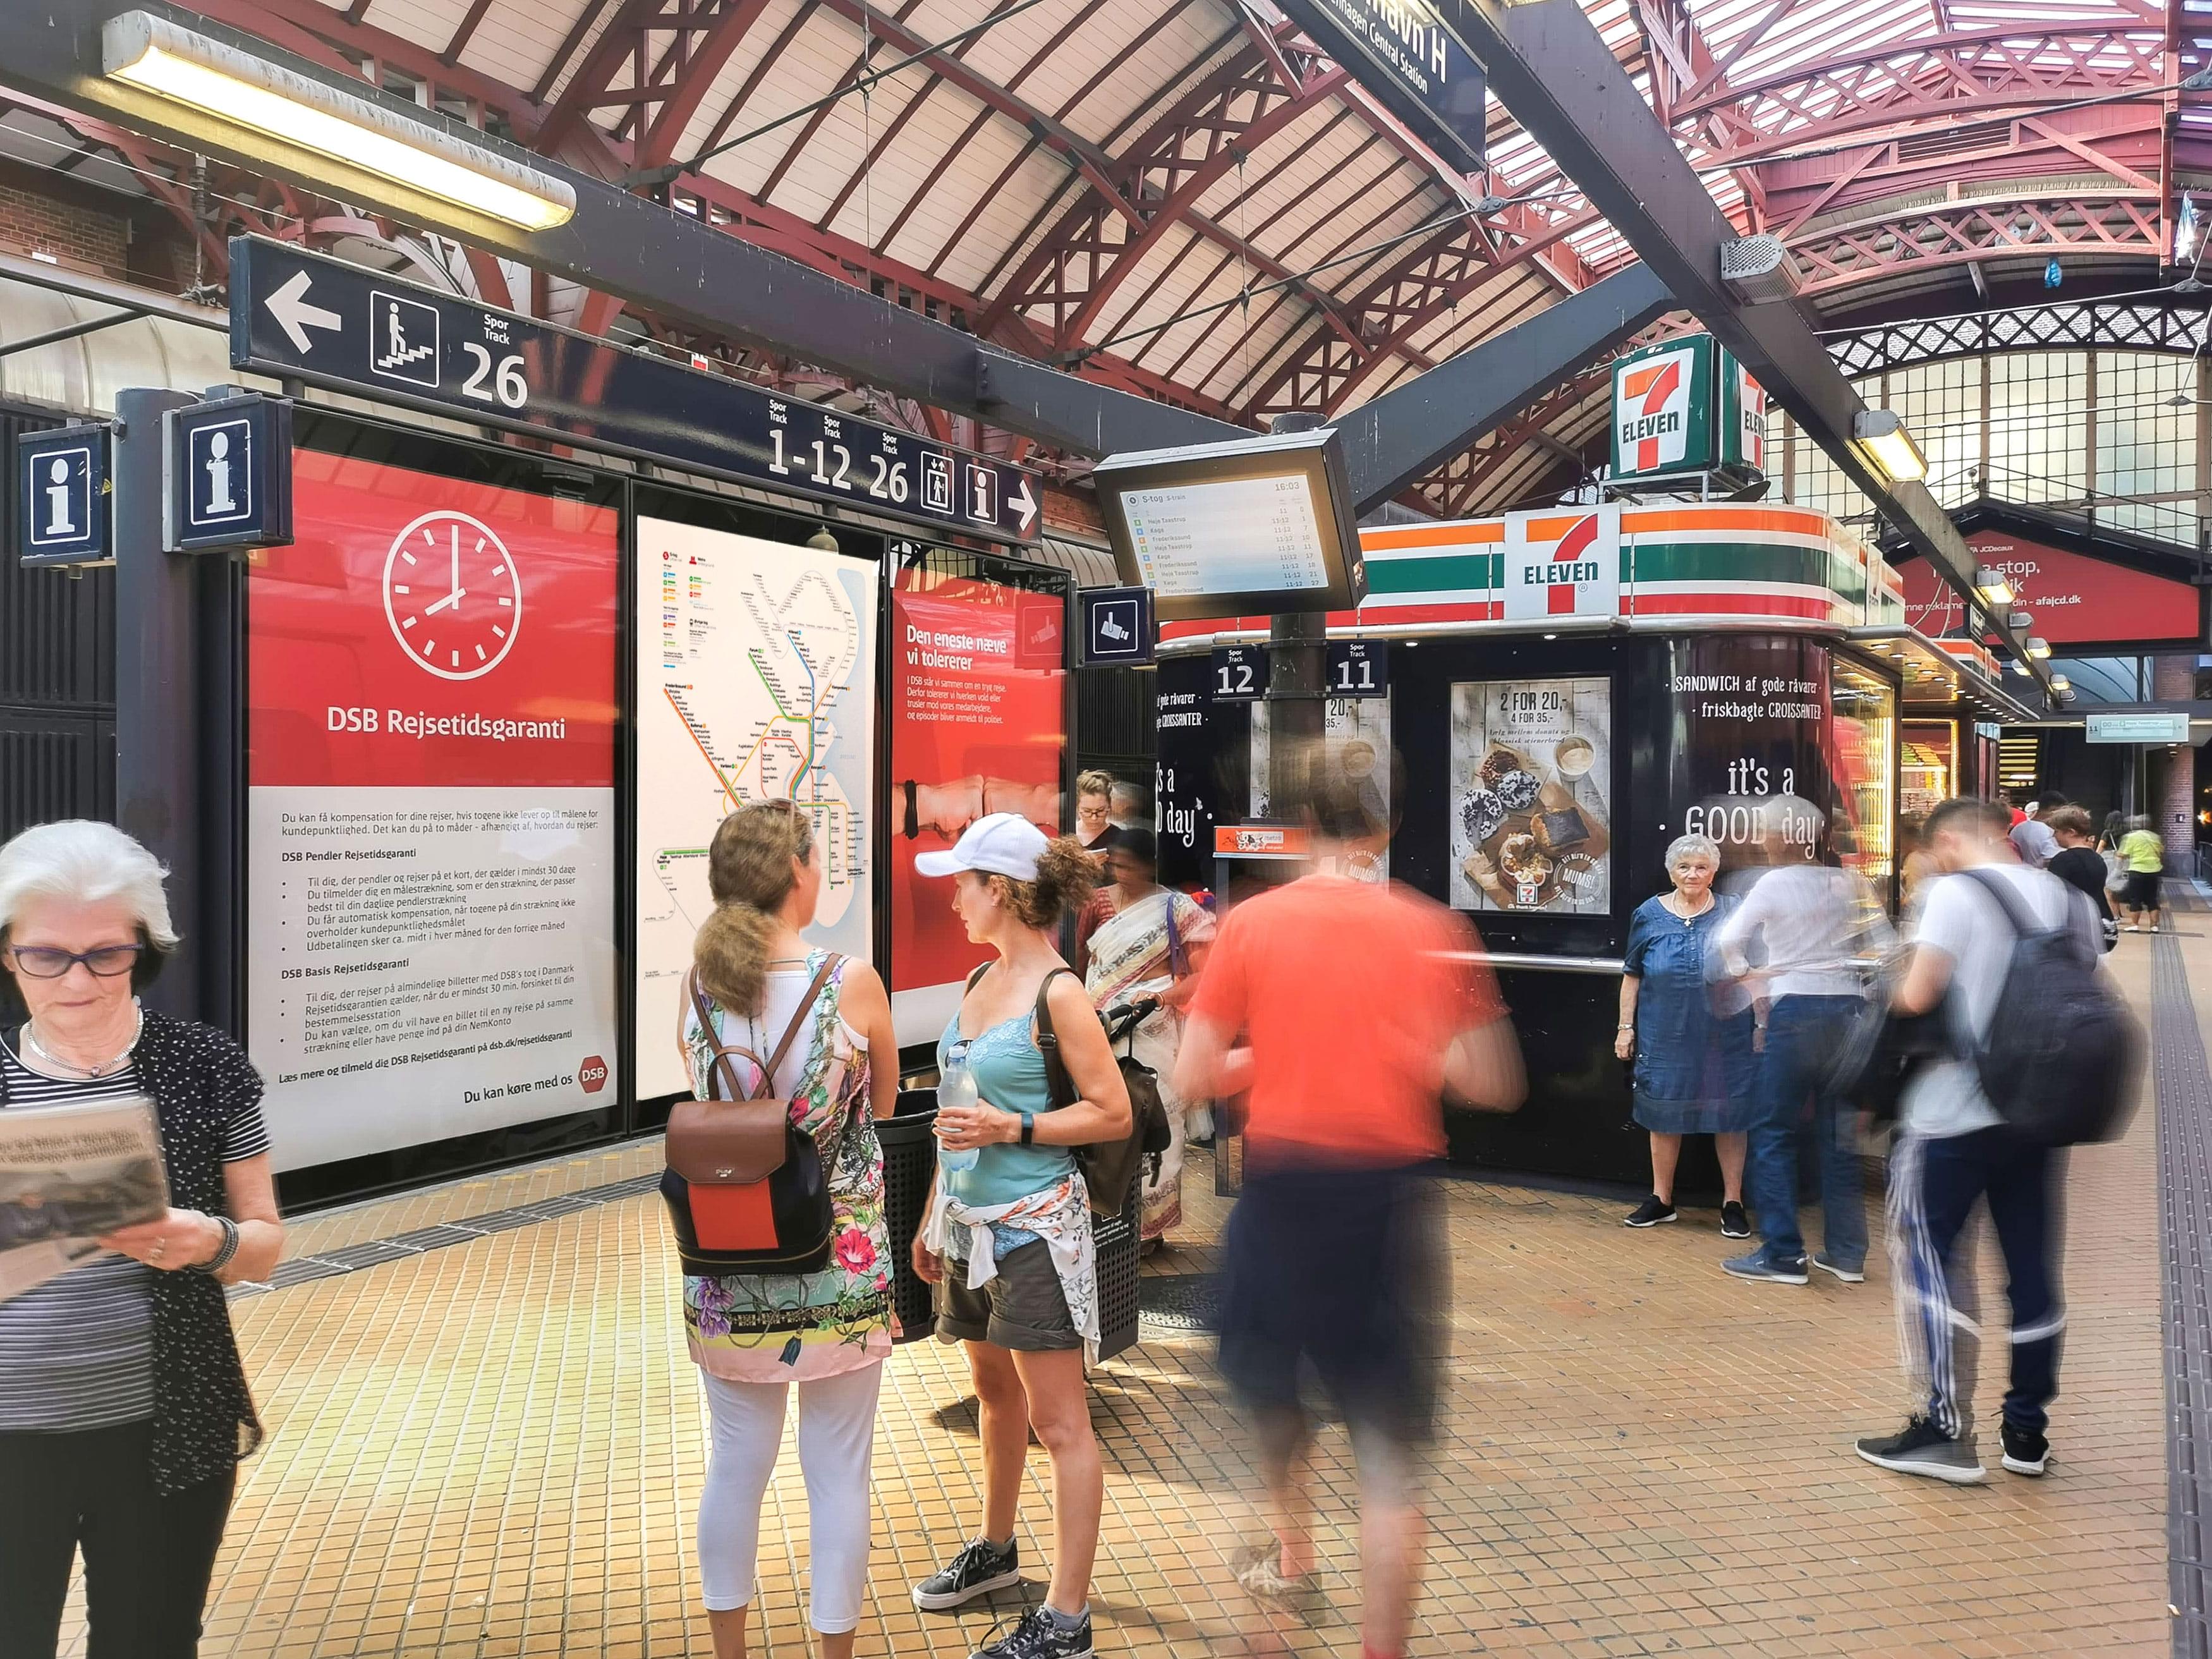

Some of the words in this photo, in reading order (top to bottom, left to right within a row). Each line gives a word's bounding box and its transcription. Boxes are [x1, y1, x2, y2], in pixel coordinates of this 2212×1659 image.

[1370, 22, 1399, 66] Central
[1401, 52, 1428, 95] Station
[1431, 27, 1445, 84] H
[484, 313, 509, 331] Spor
[483, 328, 510, 346] Track
[462, 342, 528, 409] 26
[769, 399, 787, 414] Spor
[769, 410, 787, 425] Track
[823, 415, 840, 429] Spor
[823, 425, 841, 439] Track
[882, 432, 897, 445] Spor
[882, 442, 897, 456] Track
[769, 429, 851, 490] 1-12
[870, 454, 908, 504] 26
[1275, 482, 1299, 491] 16:03
[1142, 495, 1164, 504] S-tog
[2036, 595, 2081, 607] afajcd.dk
[906, 624, 931, 645] Den
[934, 631, 973, 650] eneste
[976, 638, 1007, 653] næve
[1350, 643, 1364, 652] Spor
[906, 648, 918, 665] vi
[921, 649, 972, 671] tolererer
[1228, 649, 1243, 659] Spor
[941, 679, 964, 688] sammen
[1217, 665, 1254, 693] 12
[1337, 660, 1375, 689] 11
[1675, 675, 1740, 693] SANDWICH
[1745, 674, 1756, 691] af
[1762, 677, 1785, 696] gode
[1788, 677, 1818, 695] råvarer
[1170, 693, 1196, 705] råvarer
[1500, 693, 1508, 711] 2
[1513, 692, 1536, 710] FOR
[1511, 713, 1516, 723] 4
[1519, 713, 1534, 722] FOR
[1701, 702, 1764, 722] friskbagte
[1768, 703, 1821, 720] CROISSANTER
[327, 707, 379, 732] DSB
[387, 709, 566, 742] Rejsetidsgaranti
[1167, 768, 1175, 793] a
[1727, 758, 1769, 796] it's
[1782, 767, 1795, 796] a
[1167, 801, 1195, 848] day
[1685, 805, 1768, 845] GOOD
[1781, 806, 1816, 860] day
[281, 851, 303, 861] DSB
[305, 851, 343, 861] Pendler
[344, 849, 416, 860] Rejsetidsgaranti
[307, 890, 320, 899] Du
[323, 887, 363, 898] tilmelder
[365, 886, 379, 897] dig
[456, 883, 473, 892] som
[484, 880, 499, 889] den
[553, 877, 576, 886] passer
[1562, 868, 1595, 889] MUMS!
[307, 902, 332, 912] bedst
[334, 901, 344, 910] til
[347, 900, 361, 909] din
[363, 899, 394, 909] daglige
[396, 895, 466, 908] pendlerstrækning
[307, 915, 320, 925] Du
[323, 914, 336, 924] får
[338, 911, 388, 923] automatisk
[454, 905, 468, 914] når
[470, 905, 497, 913] togene
[498, 902, 508, 913] på
[509, 902, 521, 910] din
[523, 899, 559, 909] strækning
[561, 898, 576, 906] ikke
[307, 926, 358, 938] overholder
[360, 918, 465, 933] kundepunktlighedsmålet
[281, 968, 303, 979] DSB
[305, 966, 331, 976] Basis
[334, 959, 409, 974] Rejsetidsgaranti
[305, 1009, 401, 1028] bestemmelsesstation
[279, 1074, 298, 1083] Læs
[300, 1069, 325, 1079] mere
[326, 1067, 339, 1076] og
[341, 1060, 373, 1073] tilmeld
[374, 1058, 389, 1068] dig
[391, 1055, 409, 1066] DSB
[411, 1045, 475, 1062] Rejsetidsgaranti
[477, 1043, 488, 1054] på
[489, 1031, 572, 1049] dsb.dk/rejsetidsgaranti
[581, 1066, 604, 1083] DSB
[464, 1091, 480, 1103] Du
[483, 1088, 504, 1100] kan
[506, 1083, 532, 1095] køre
[534, 1076, 558, 1090] med
[560, 1074, 573, 1085] os
